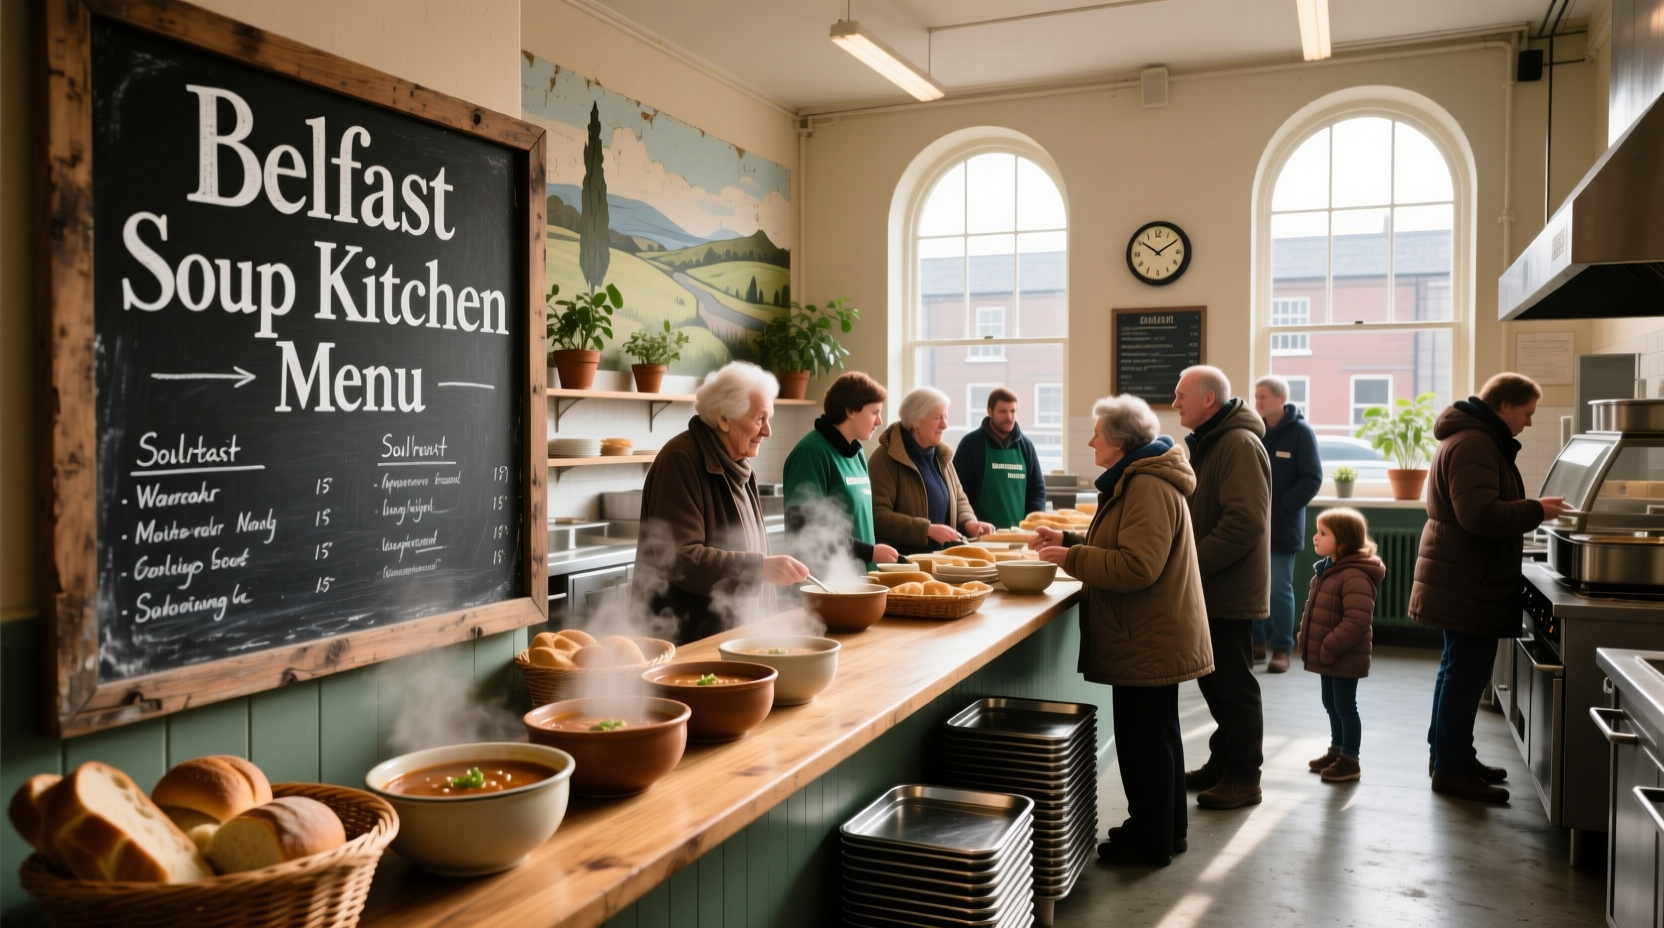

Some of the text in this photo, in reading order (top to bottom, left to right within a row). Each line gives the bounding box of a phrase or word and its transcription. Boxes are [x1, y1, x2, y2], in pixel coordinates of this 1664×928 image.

[186, 84, 455, 240] Belfast
[123, 211, 509, 338] Soup Kitchen
[275, 341, 426, 412] Menu
[316, 477, 333, 495] 15
[315, 508, 331, 526] 15
[315, 542, 333, 560] 15
[315, 576, 335, 594] 15
